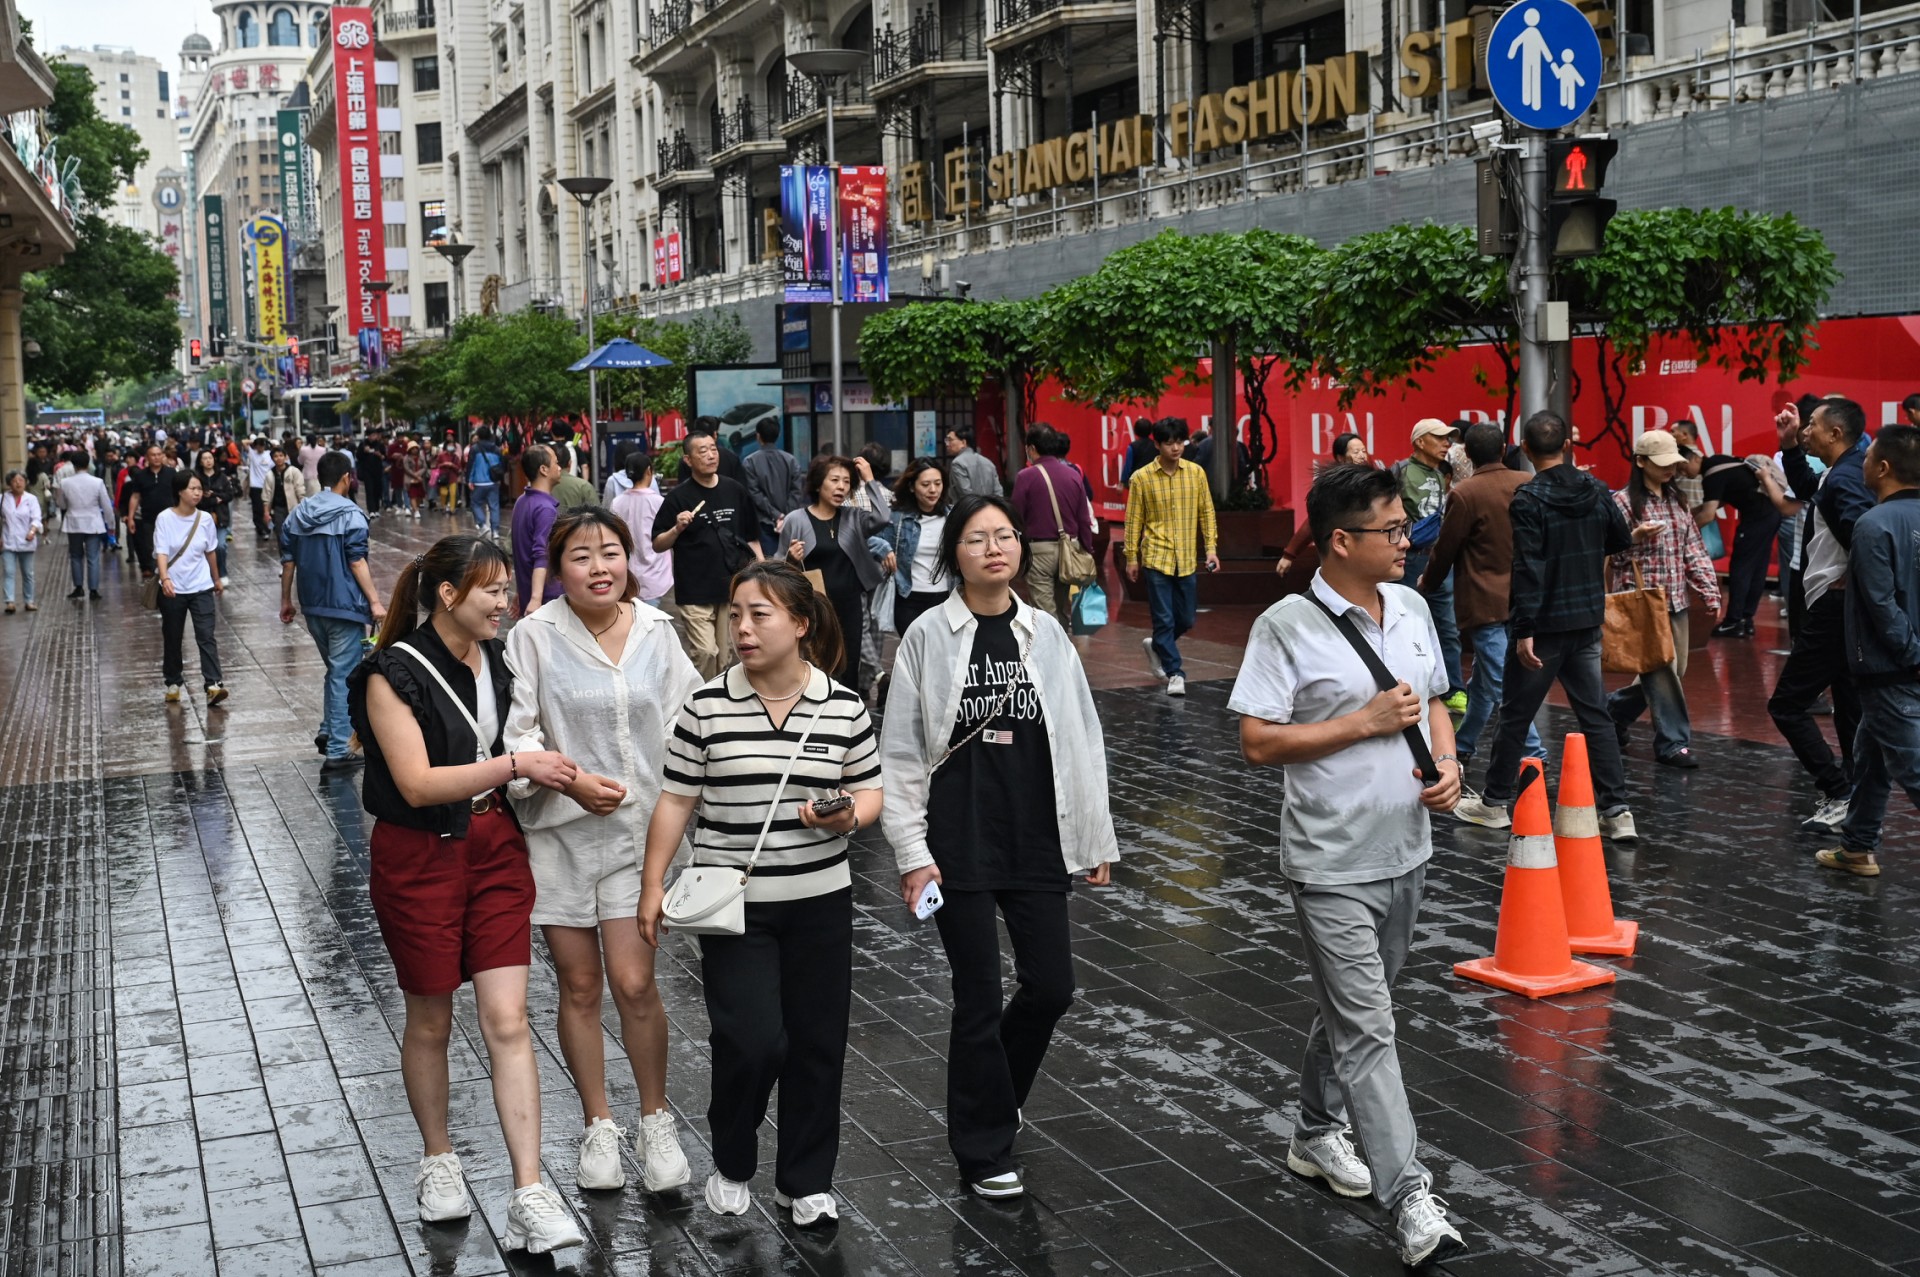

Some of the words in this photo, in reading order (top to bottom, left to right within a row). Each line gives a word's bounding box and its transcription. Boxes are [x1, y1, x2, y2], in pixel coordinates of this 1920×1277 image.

[346, 57, 372, 219] 上海市第一食品商店
[987, 114, 1146, 201] SHANGHAI
[1170, 51, 1360, 158] FASHION
[357, 228, 372, 257] First
